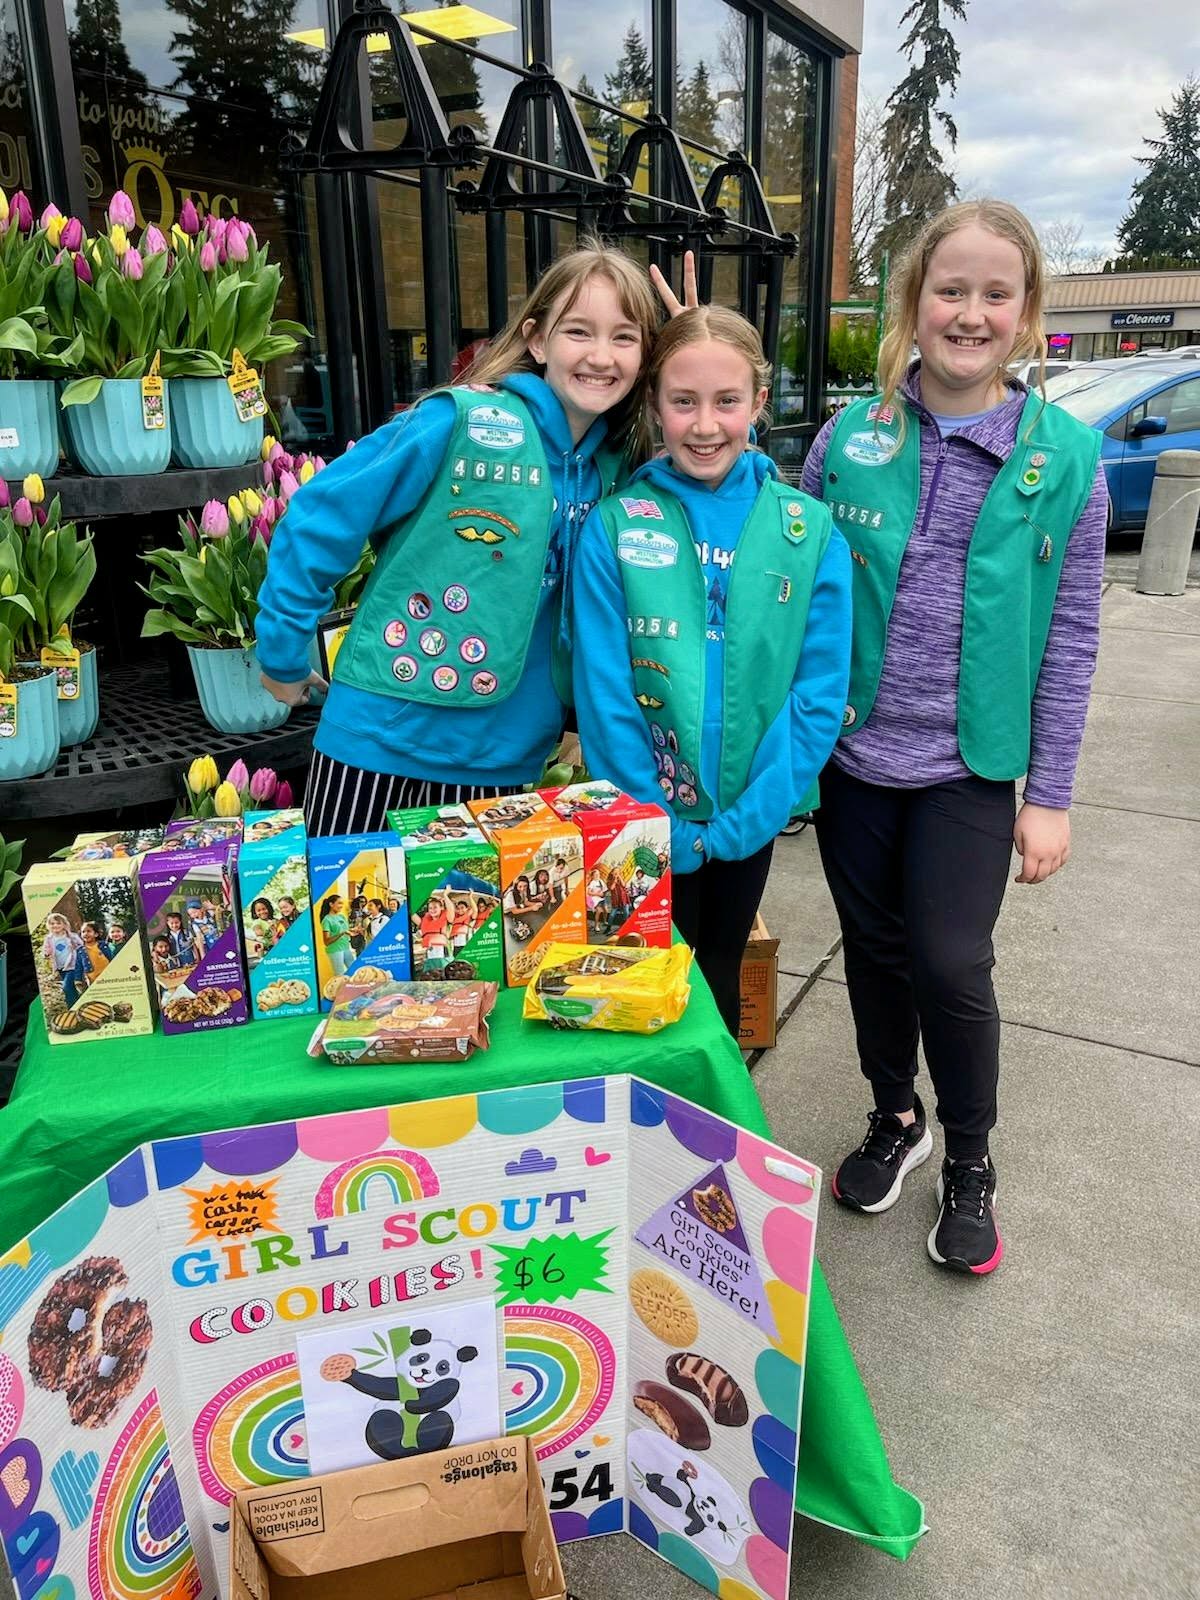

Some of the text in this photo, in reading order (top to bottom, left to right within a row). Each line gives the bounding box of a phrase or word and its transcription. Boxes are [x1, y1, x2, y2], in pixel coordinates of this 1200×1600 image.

[79, 91, 106, 124] to
[1126, 314, 1171, 325] Cleaners
[480, 435, 513, 443] WASHINGTON
[454, 459, 540, 485] 46254
[636, 538, 661, 547] SCOUTS
[154, 880, 172, 888] scouts
[483, 931, 498, 939] thin
[205, 1217, 238, 1229] card
[172, 1189, 587, 1288] GIRL SCOUT
[670, 1210, 751, 1276] Girl Scout
[652, 1233, 759, 1320] Are Here!
[189, 1250, 484, 1344] COOKIES!
[640, 1296, 688, 1323] LEADER
[444, 1446, 517, 1469] DO NOT DROP
[254, 1494, 317, 1513] DRY LOCATION
[255, 1506, 318, 1524] KEEP IN A COOL
[256, 1516, 319, 1537] Perishable
